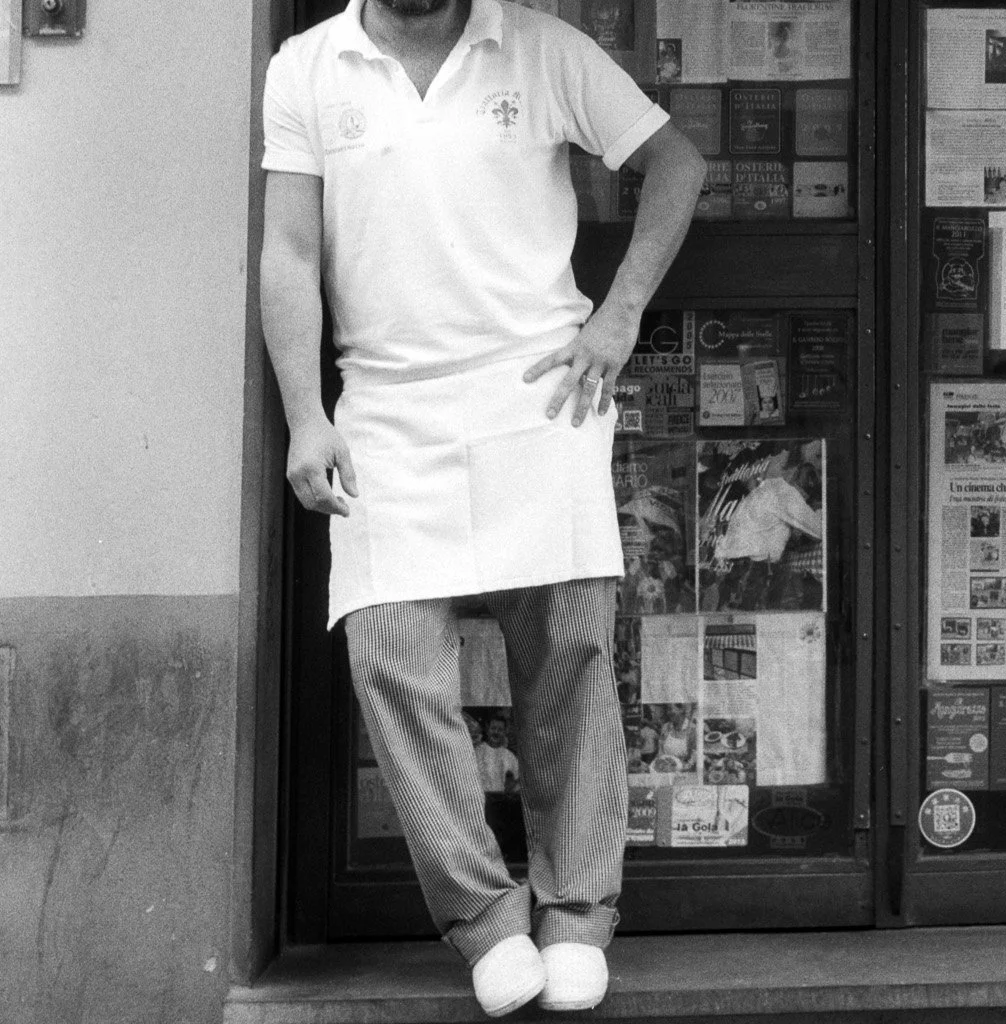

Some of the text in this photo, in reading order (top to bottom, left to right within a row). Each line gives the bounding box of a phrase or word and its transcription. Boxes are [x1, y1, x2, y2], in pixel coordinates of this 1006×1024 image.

[671, 355, 692, 365] GO
[950, 482, 963, 493] Un
[964, 482, 995, 493] cinema
[692, 821, 719, 832] Gola
